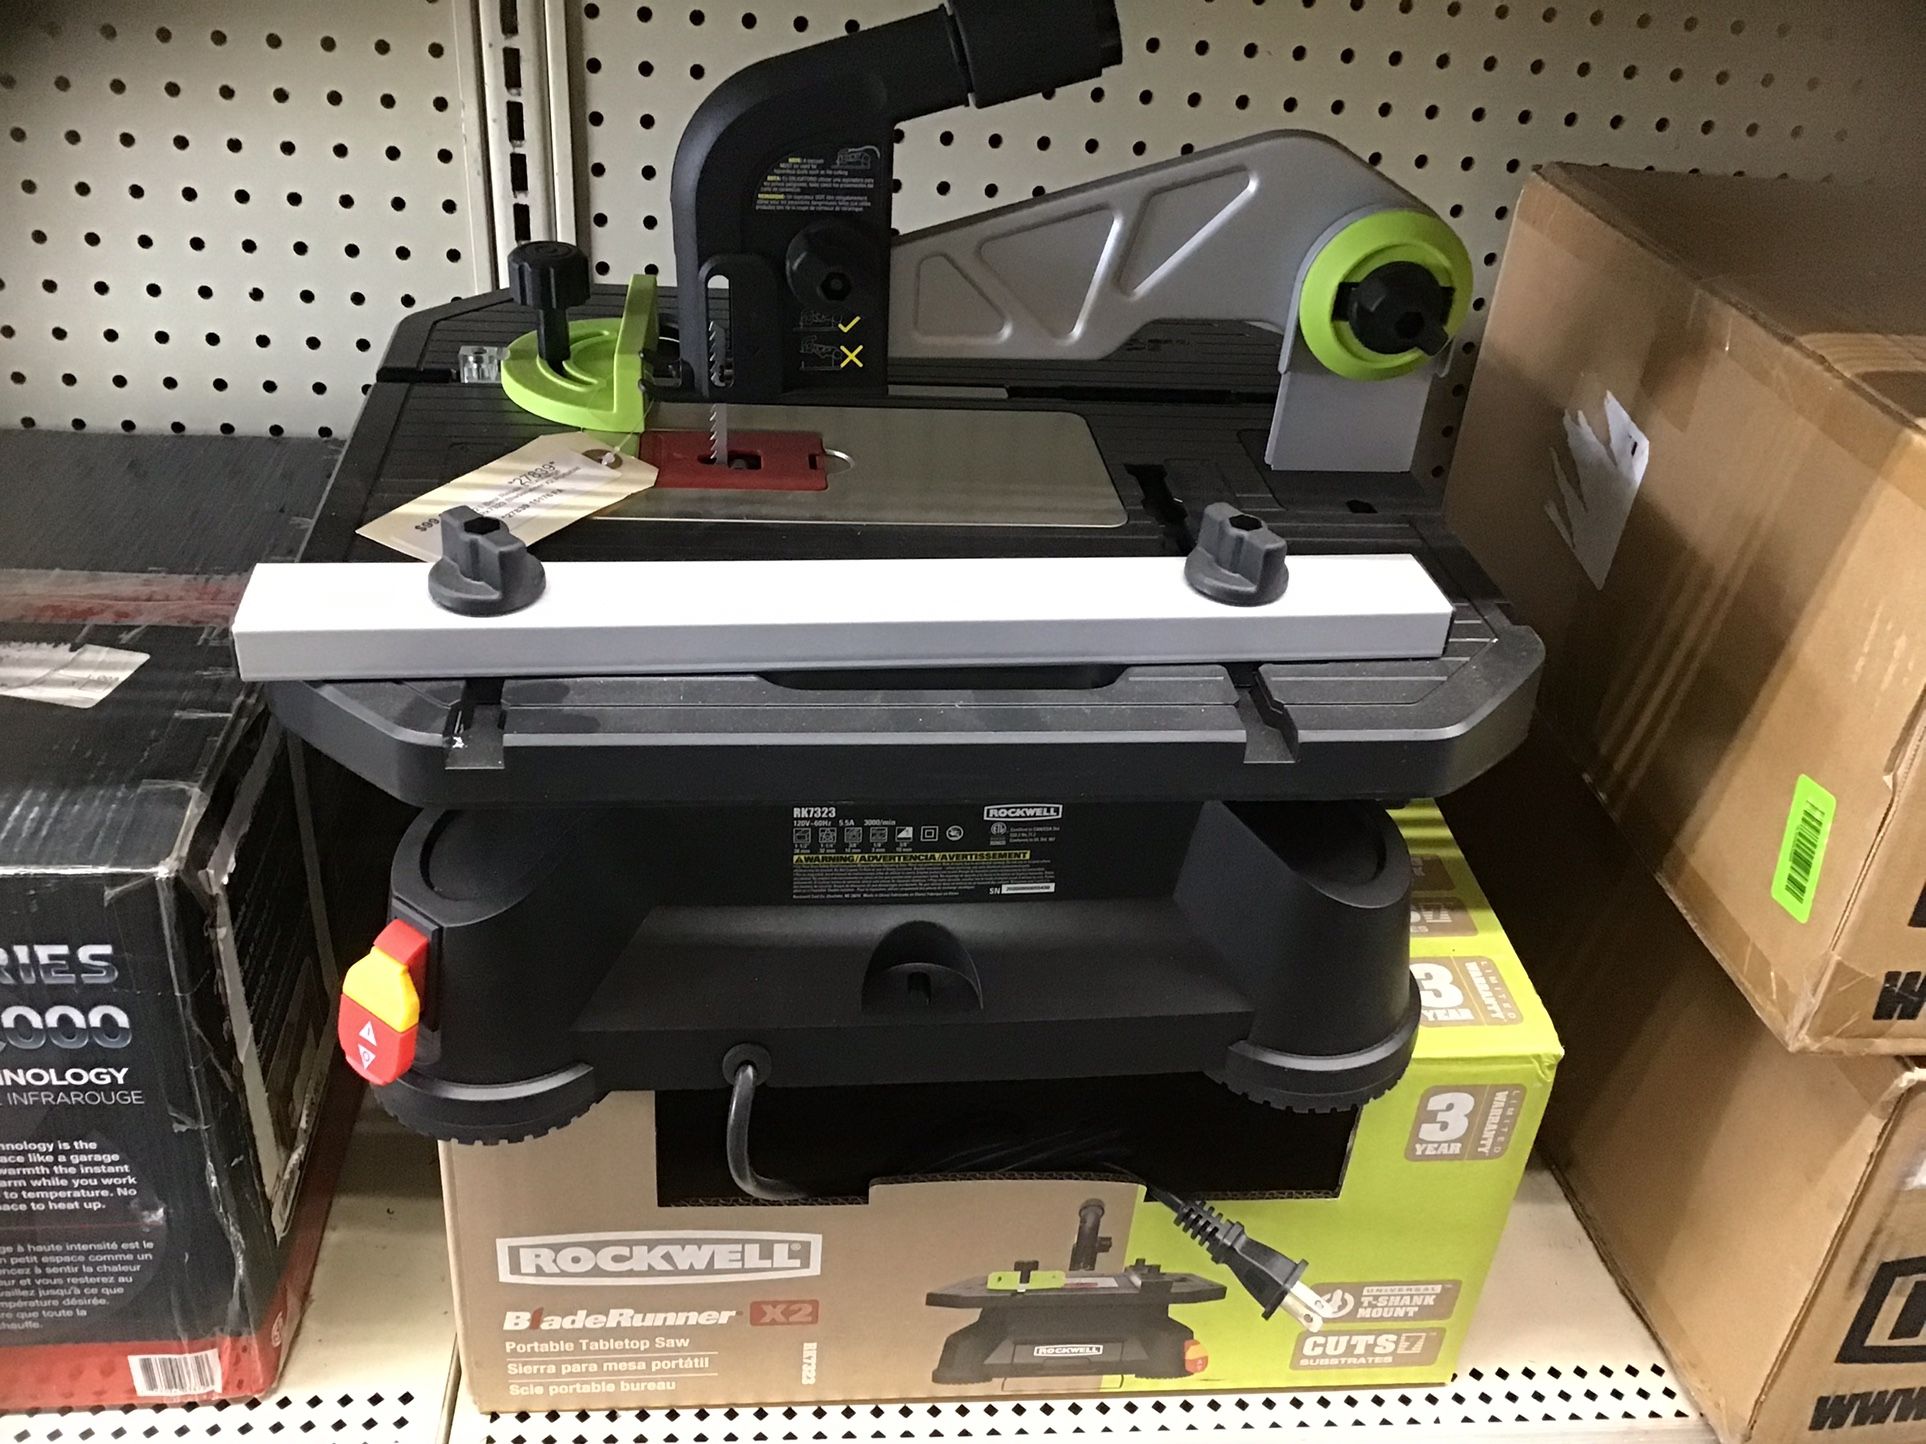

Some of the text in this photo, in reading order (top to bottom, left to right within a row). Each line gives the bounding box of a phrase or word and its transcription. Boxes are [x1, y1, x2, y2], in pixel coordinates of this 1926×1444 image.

[793, 807, 836, 818] RK7323
[989, 807, 1057, 817] ROCKWELL
[989, 887, 1001, 895] SN
[1409, 963, 1464, 1008] 3
[1421, 1007, 1475, 1021] YEAR
[0, 1068, 129, 1086] NOLOGY
[7, 1091, 145, 1105] INFRAROUGE
[1419, 1092, 1475, 1142] 3
[1477, 1090, 1509, 1155] WARRANTY
[58, 1140, 71, 1150] is
[73, 1139, 97, 1150] the
[1415, 1143, 1462, 1155] YEAR
[28, 1153, 54, 1162] like
[58, 1154, 67, 1162] a
[70, 1154, 120, 1164] garage
[53, 1164, 77, 1174] the
[80, 1164, 130, 1173] instant
[30, 1177, 69, 1187] while
[72, 1178, 98, 1188] you
[101, 1175, 137, 1185] work
[3, 1187, 137, 1200] to temperature. No
[31, 1202, 45, 1211] to
[48, 1200, 80, 1210] heat
[83, 1201, 106, 1211] up.
[27, 1243, 63, 1252] haute
[66, 1241, 118, 1252] intensité
[121, 1241, 140, 1250] est
[142, 1240, 154, 1249] le
[10, 1255, 39, 1265] petit
[41, 1254, 86, 1264] espace
[88, 1253, 134, 1262] comme
[137, 1253, 153, 1261] un
[519, 1243, 801, 1274] ROCKWELL
[45, 1265, 79, 1274] sentir
[82, 1264, 94, 1273] la
[96, 1264, 141, 1273] chaleur
[19, 1278, 32, 1286] et
[34, 1278, 64, 1286] vous
[67, 1275, 115, 1285] resterez
[118, 1276, 133, 1284] au
[83, 1287, 98, 1295] ce
[101, 1287, 124, 1296] que
[1366, 1285, 1438, 1294] UNIVERSAL
[62, 1296, 110, 1306] désirée.
[1361, 1295, 1437, 1307] T-SHANK
[16, 1311, 39, 1320] que
[42, 1309, 74, 1318] toute
[76, 1307, 87, 1317] la
[503, 1303, 813, 1331] BladeRunner X2
[1357, 1306, 1419, 1319] MOUNT
[505, 1336, 690, 1354] Portable Tabletop Saw
[1302, 1334, 1398, 1356] CUTS
[507, 1357, 709, 1375] Sierra para mesa portátil
[1300, 1356, 1393, 1366] SUBSTRATES
[509, 1380, 676, 1396] Scie portable bureau
